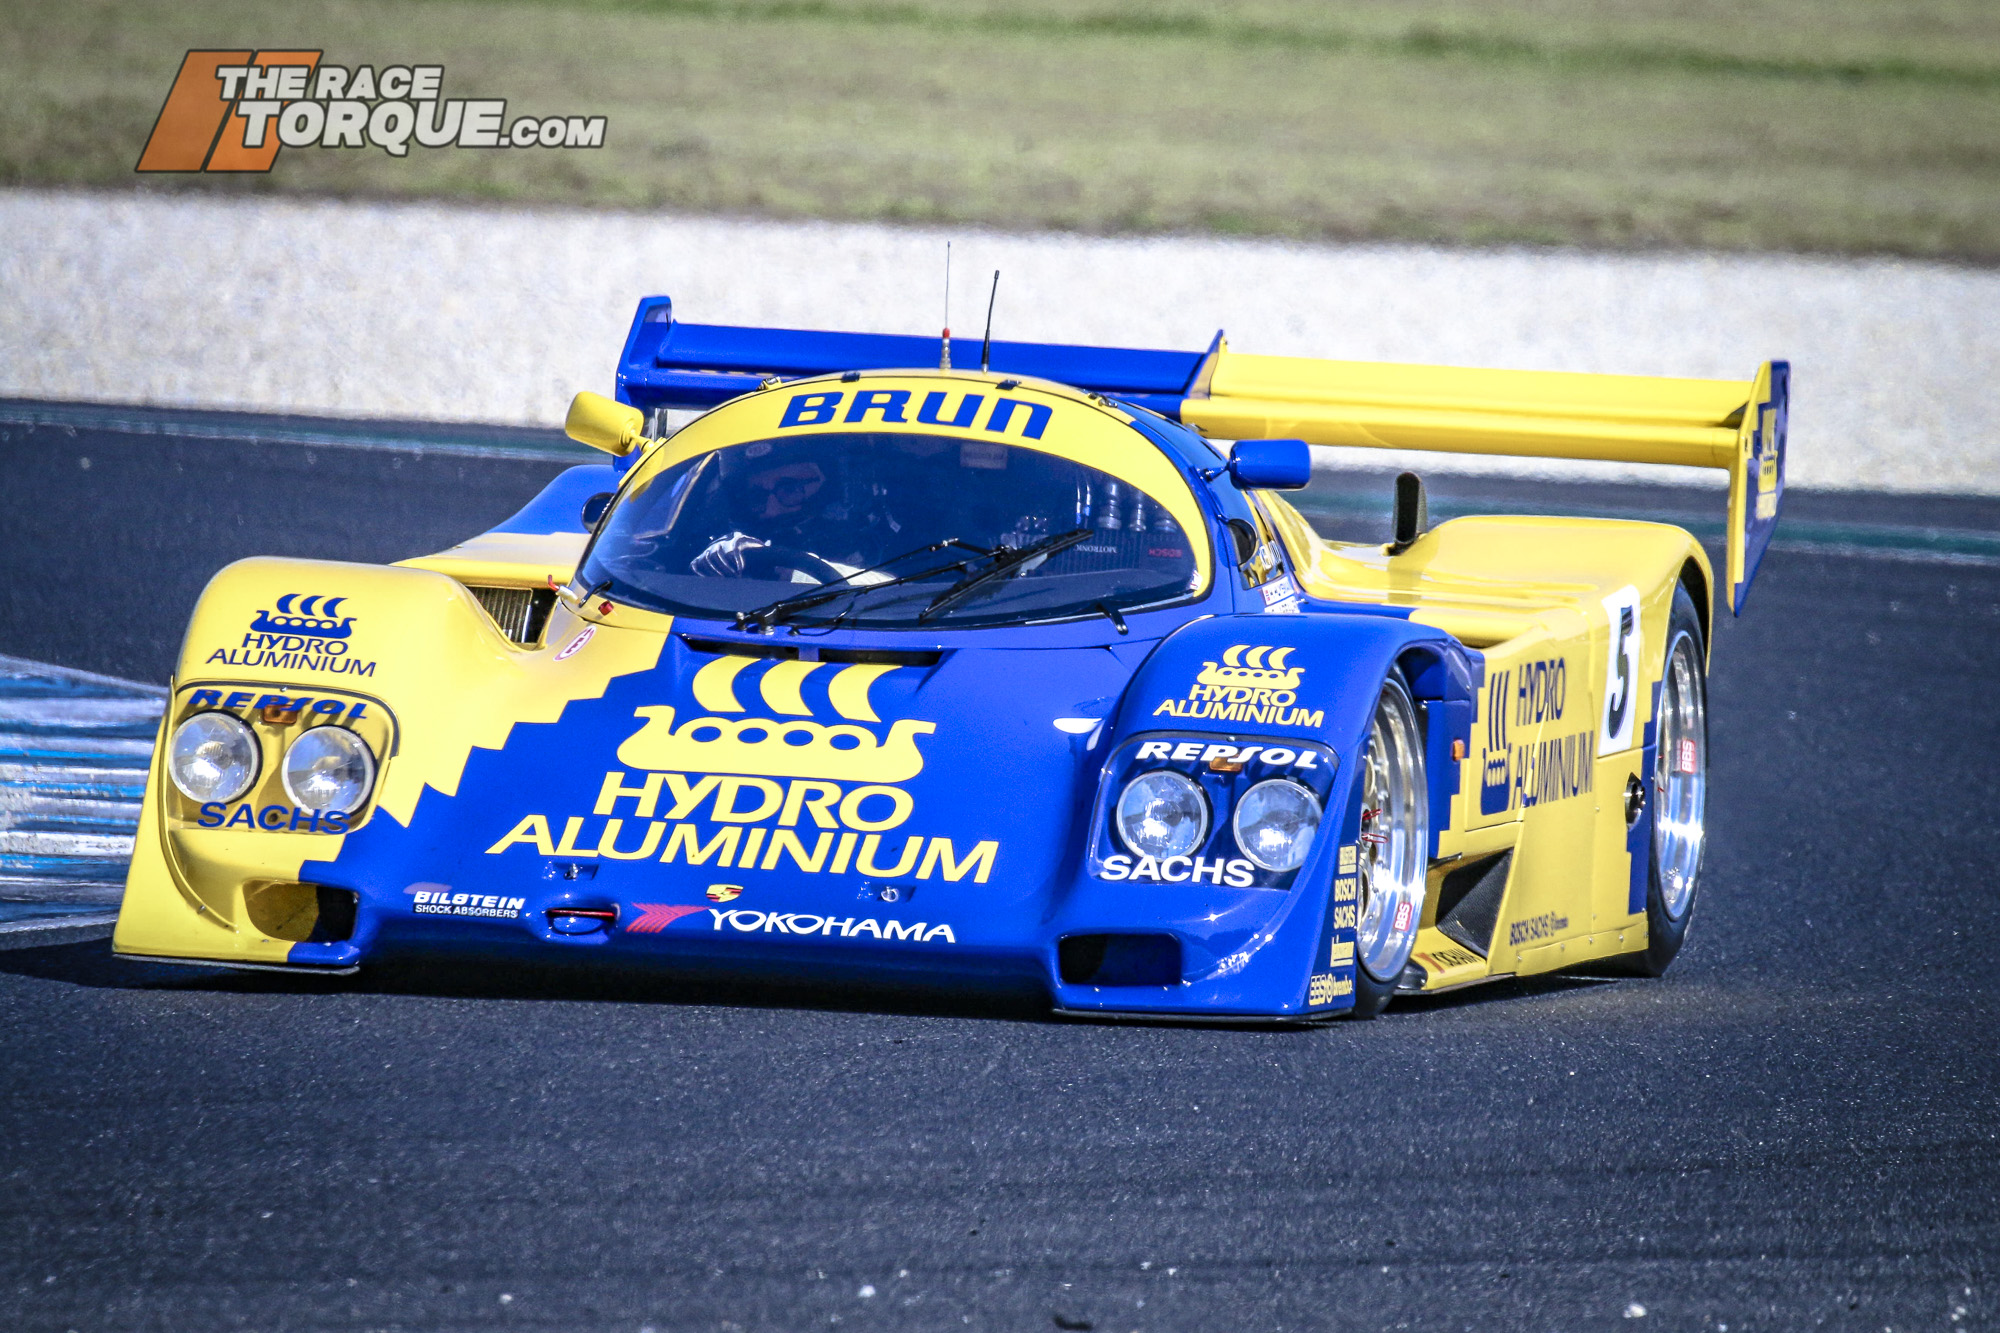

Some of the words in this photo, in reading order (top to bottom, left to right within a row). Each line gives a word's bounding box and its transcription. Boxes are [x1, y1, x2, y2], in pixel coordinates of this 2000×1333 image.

[778, 390, 1053, 440] BRUN
[241, 633, 350, 656] HYDRO
[205, 648, 377, 678] ALUMINIUM
[1608, 606, 1634, 740] 5
[188, 689, 369, 719] REPSOL
[1188, 684, 1297, 707] HYDRO
[1516, 657, 1566, 727] HYDRO
[1152, 699, 1325, 728] ALUMINIUM
[1135, 741, 1318, 770] REPSOL
[1681, 739, 1696, 773] BBS
[592, 772, 915, 833] HYDRO
[197, 802, 350, 835] SACHS
[485, 814, 1000, 883] ALUMINIUM
[1100, 855, 1255, 888] SACHS
[413, 891, 525, 910] BILSTEIN
[1334, 877, 1357, 902] BOSCH
[415, 903, 451, 915] SHOCK
[452, 905, 519, 918] ABSORBERS
[1333, 904, 1356, 929] SACHS
[1394, 903, 1410, 930] BBS
[708, 908, 957, 944] YOKOHAMA
